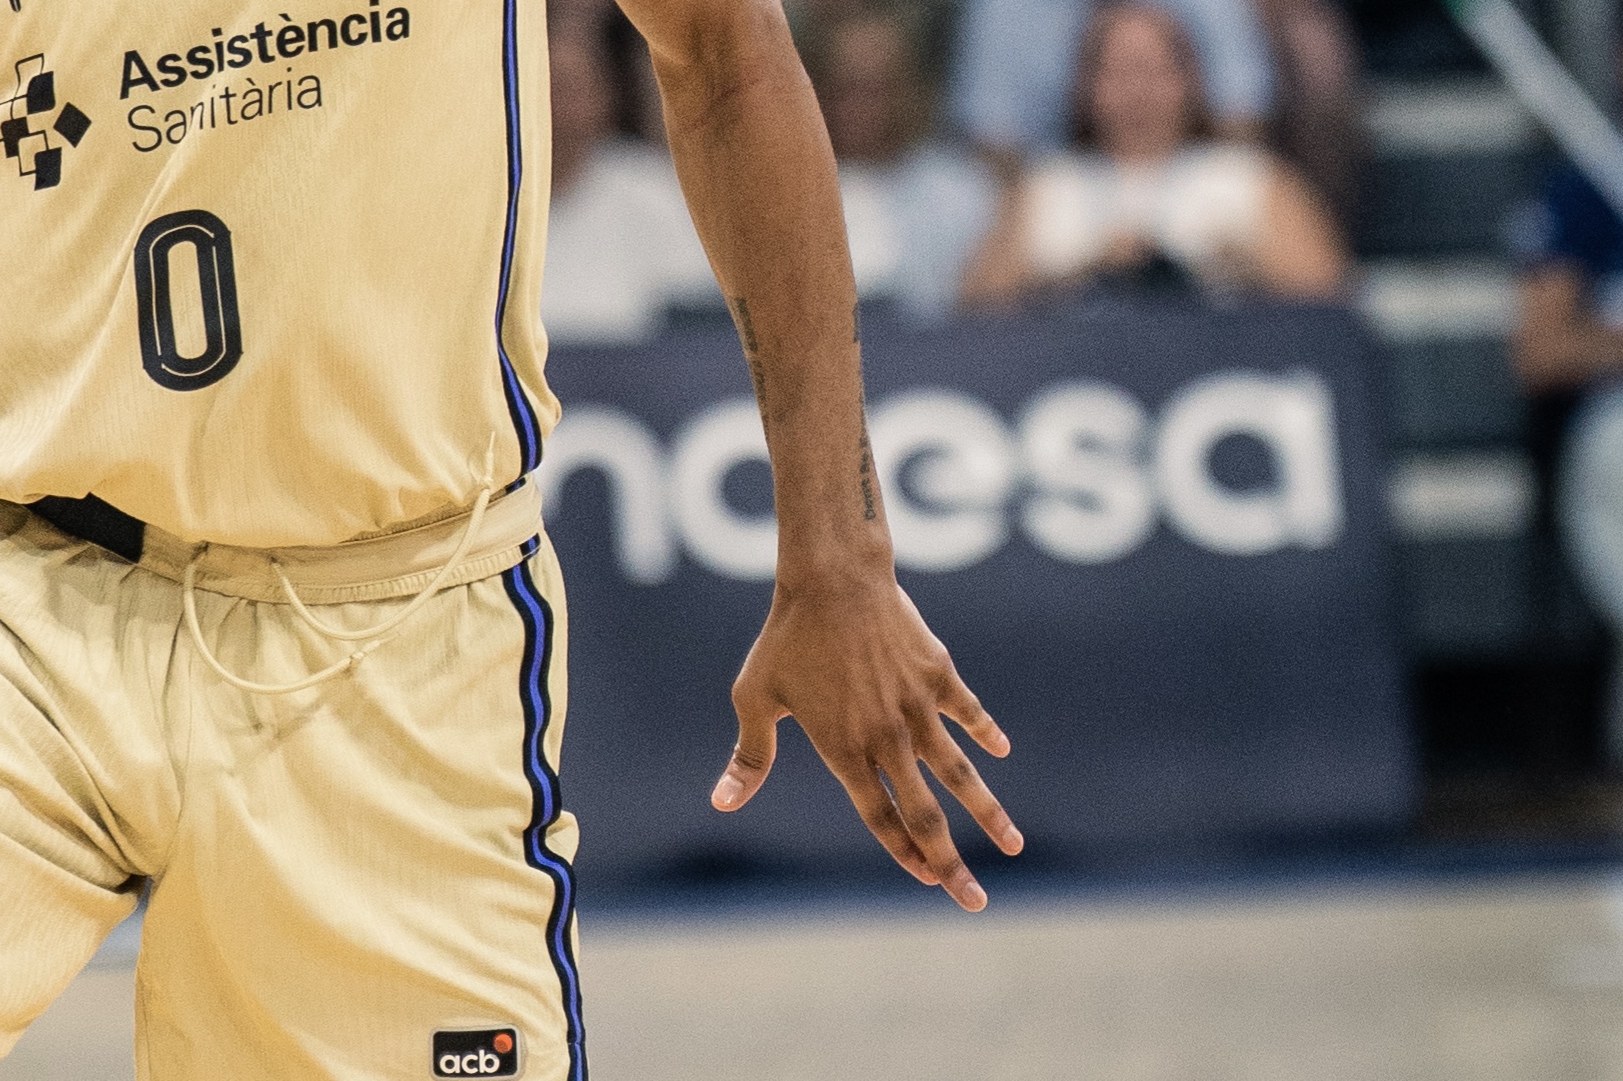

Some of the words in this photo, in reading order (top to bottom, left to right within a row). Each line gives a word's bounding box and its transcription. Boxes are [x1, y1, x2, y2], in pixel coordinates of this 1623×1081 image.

[126, 66, 323, 153] Sanitària
[133, 208, 244, 392] 0
[439, 1048, 501, 1075] acb
